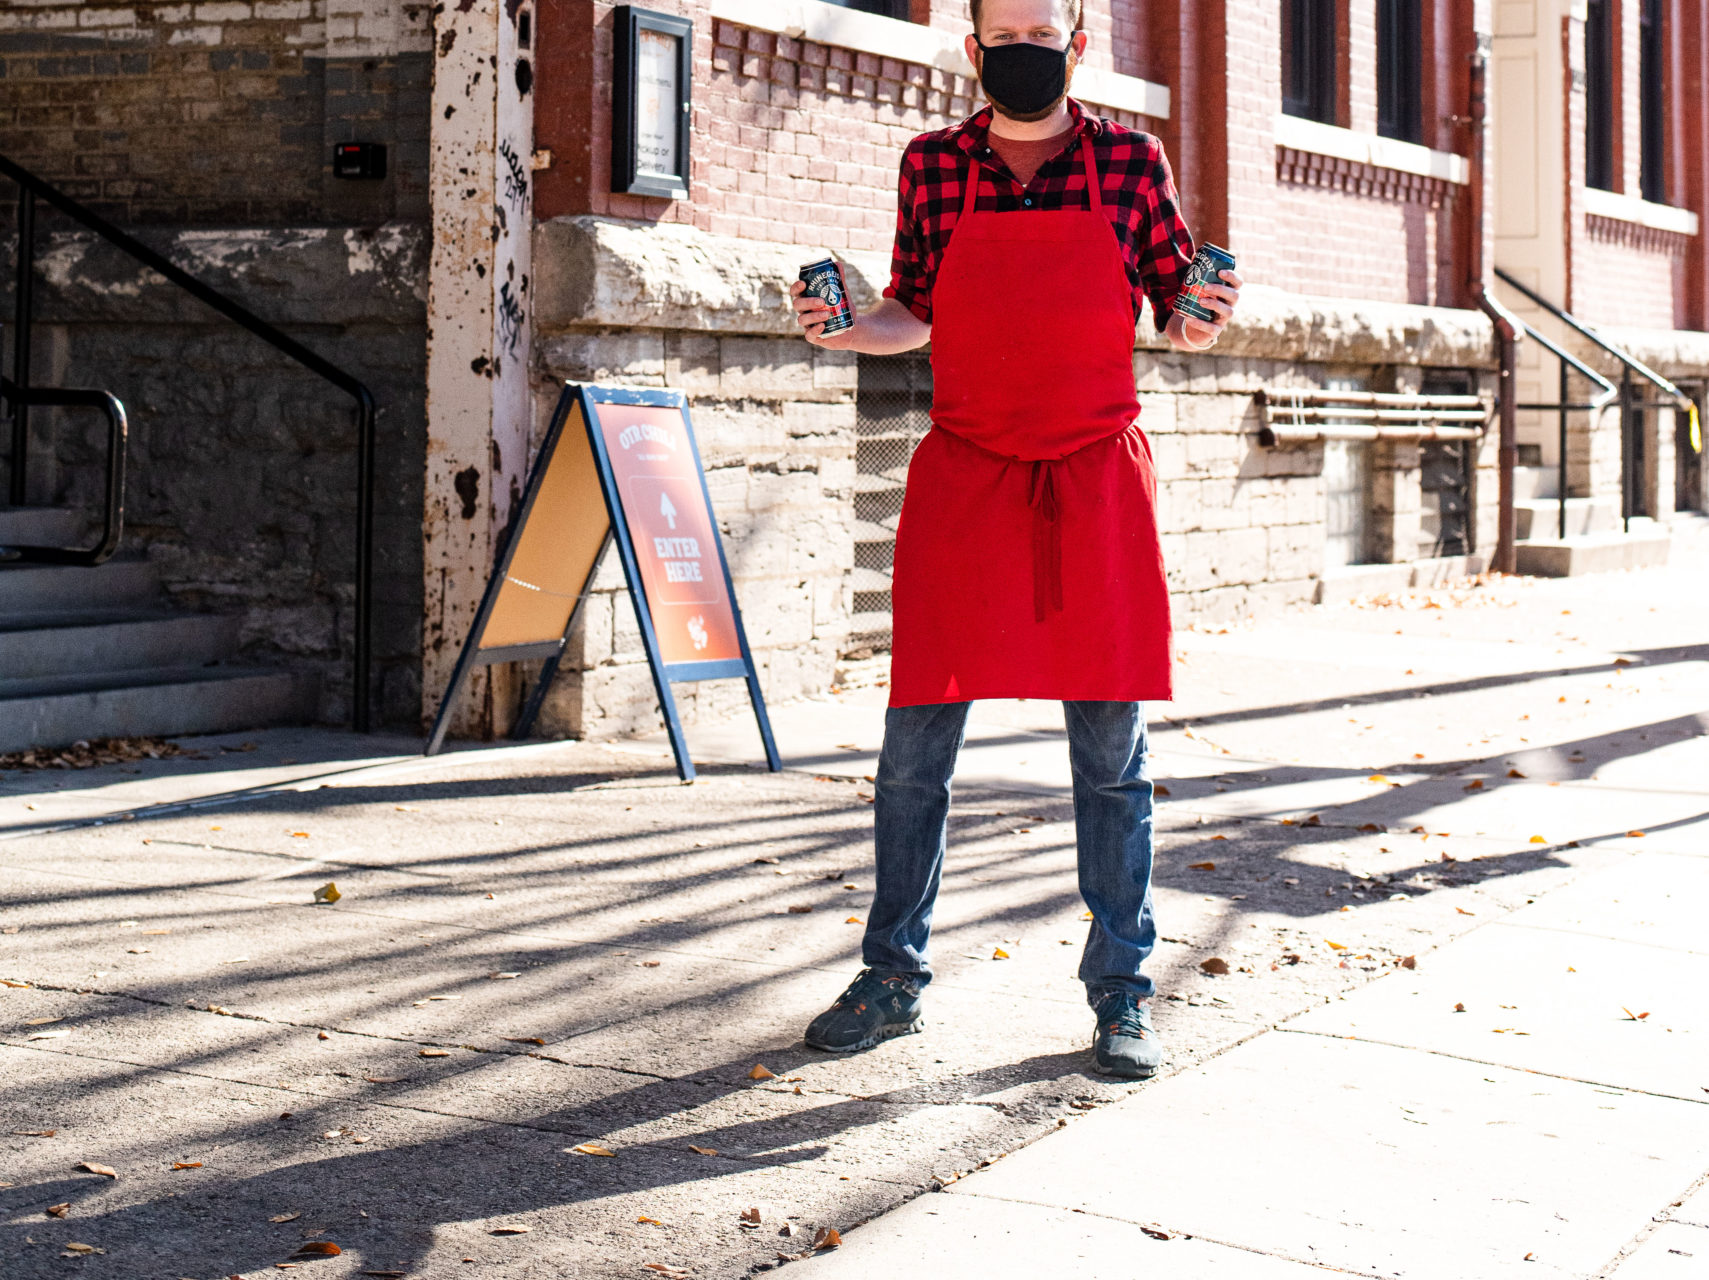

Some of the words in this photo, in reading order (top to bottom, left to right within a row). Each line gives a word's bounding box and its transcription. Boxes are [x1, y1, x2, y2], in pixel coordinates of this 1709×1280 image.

[619, 424, 642, 450] OTR
[653, 537, 701, 559] ENTER
[664, 560, 703, 582] HERE
